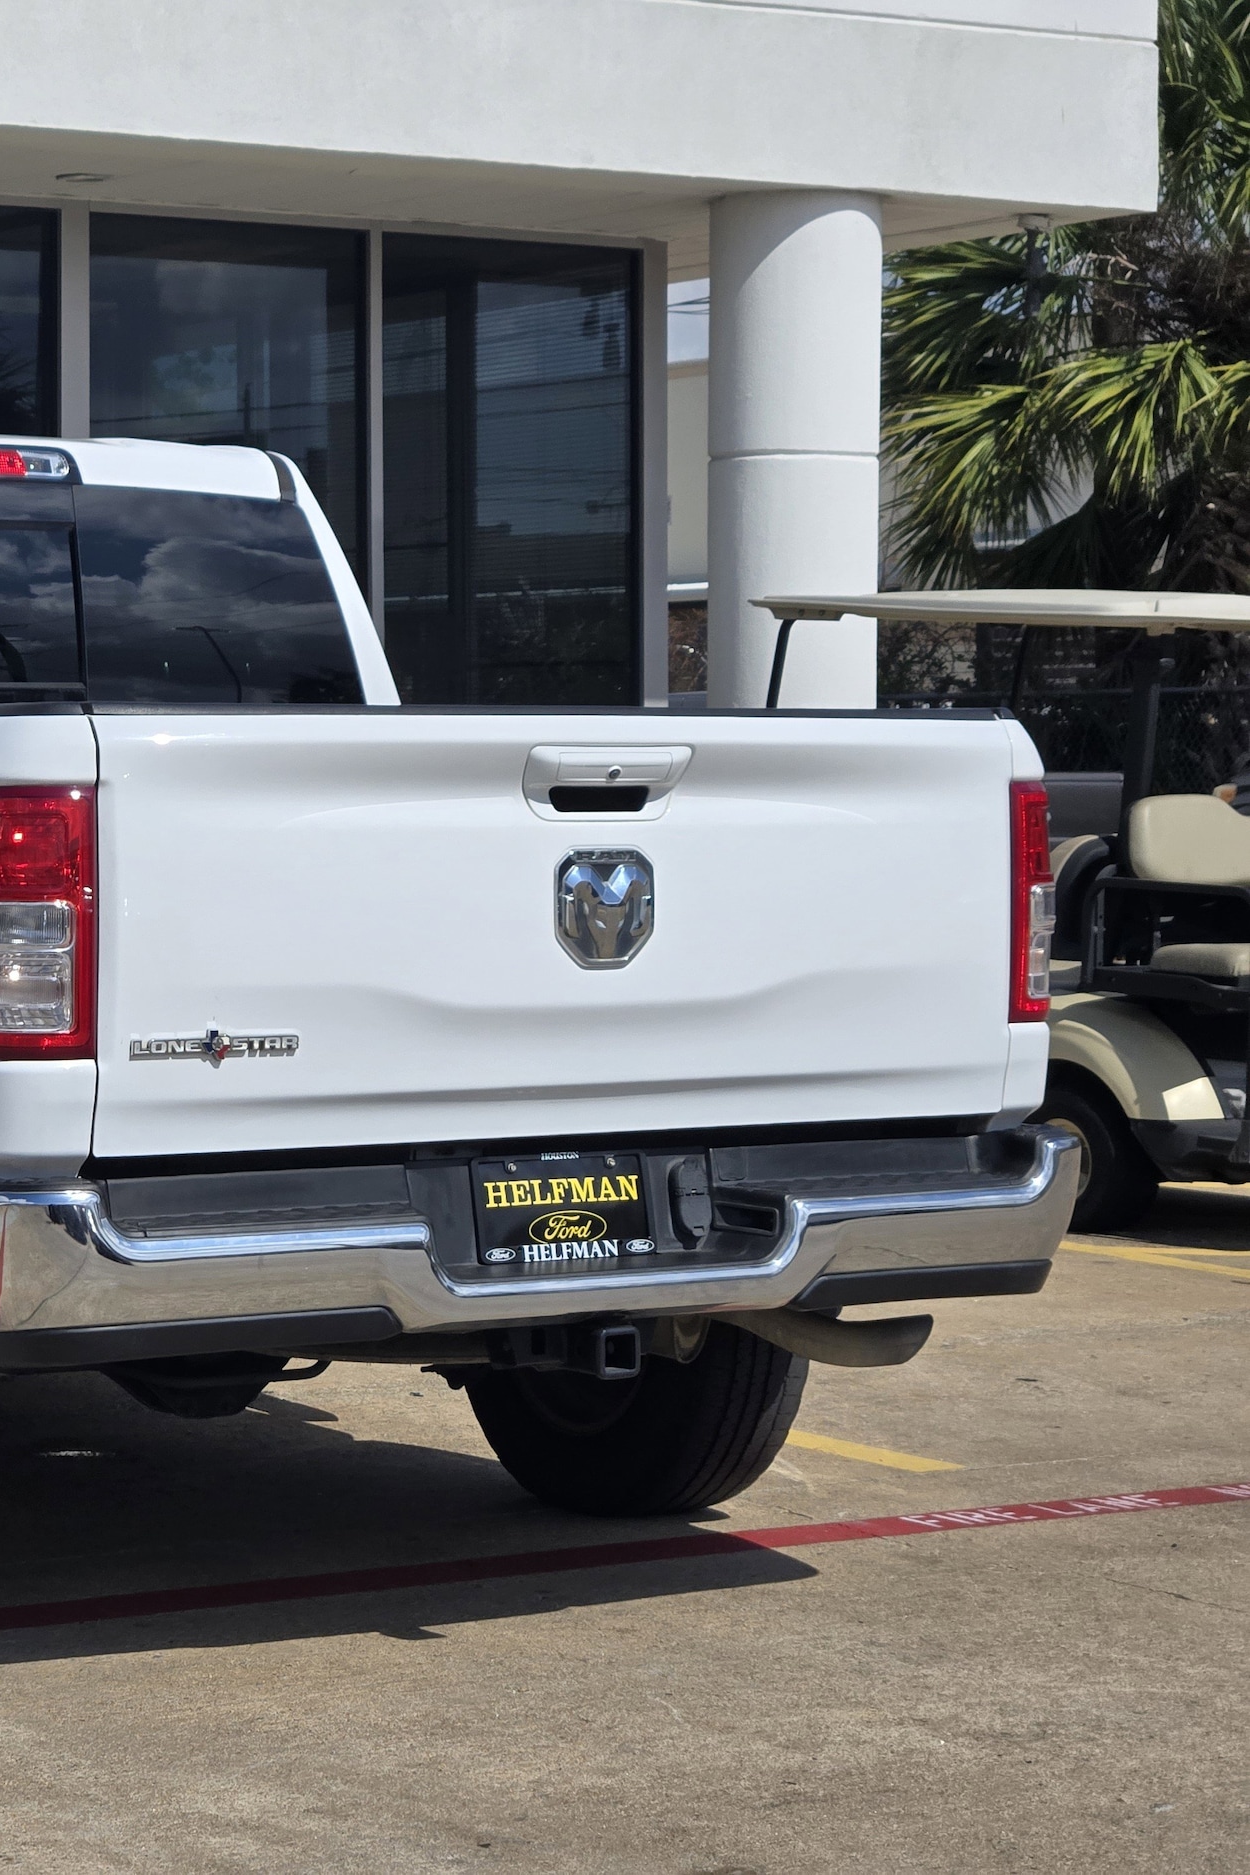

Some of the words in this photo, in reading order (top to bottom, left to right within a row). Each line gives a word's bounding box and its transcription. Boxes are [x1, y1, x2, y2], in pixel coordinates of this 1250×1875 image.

[130, 1039, 203, 1058] LONE
[231, 1035, 299, 1053] STAR
[540, 1151, 580, 1161] HOUSTON
[483, 1174, 639, 1208] HELFMAN
[543, 1214, 592, 1240] Ford
[522, 1239, 619, 1262] HELFMAN
[899, 1507, 1038, 1528] FIRE
[1028, 1494, 1181, 1512] LANE
